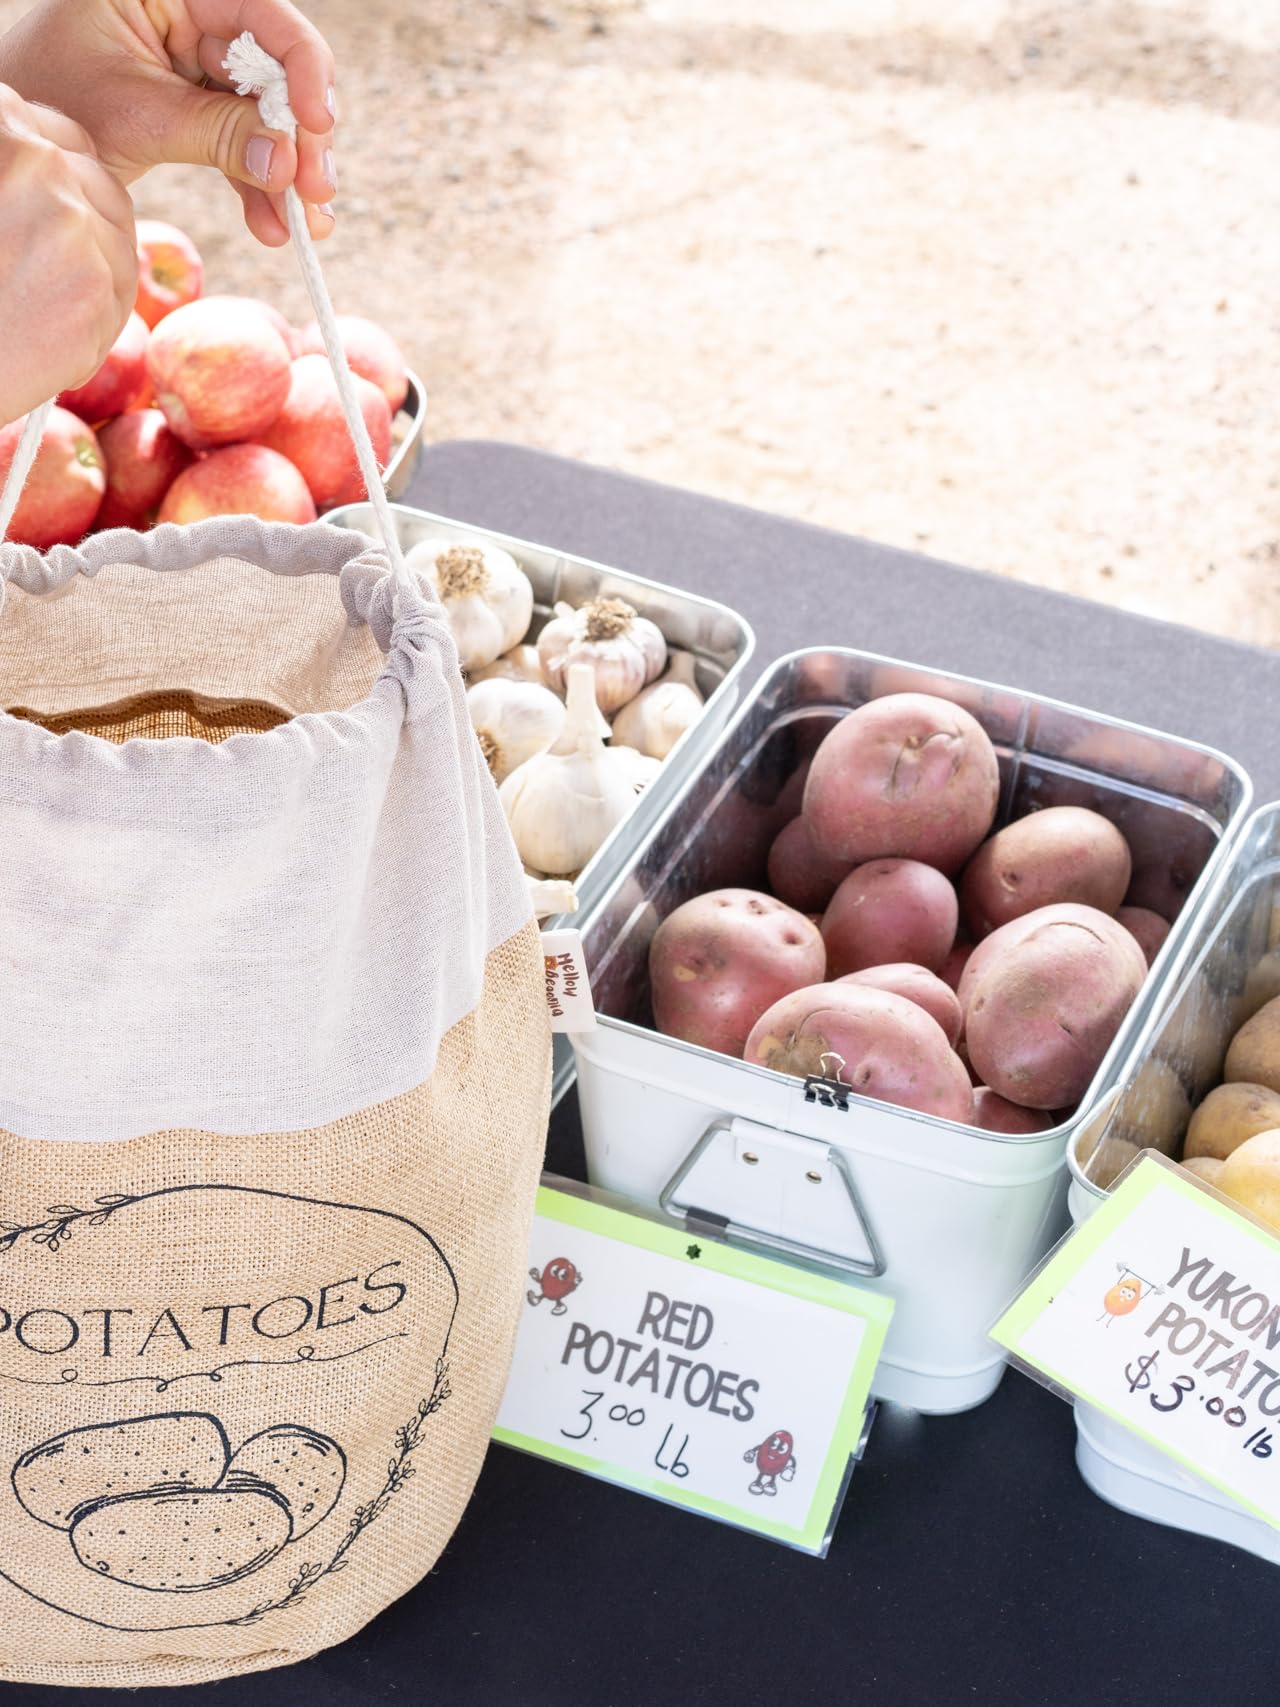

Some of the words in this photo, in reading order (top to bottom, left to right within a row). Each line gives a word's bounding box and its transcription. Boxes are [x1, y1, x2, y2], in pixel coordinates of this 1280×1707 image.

[557, 952, 580, 998] Mellow
[636, 1291, 714, 1351] RED
[1166, 1246, 1280, 1351] YUKON
[560, 1322, 760, 1423] POTATOES
[1124, 1350, 1248, 1428] $3.00
[1144, 1301, 1280, 1424] POTATO
